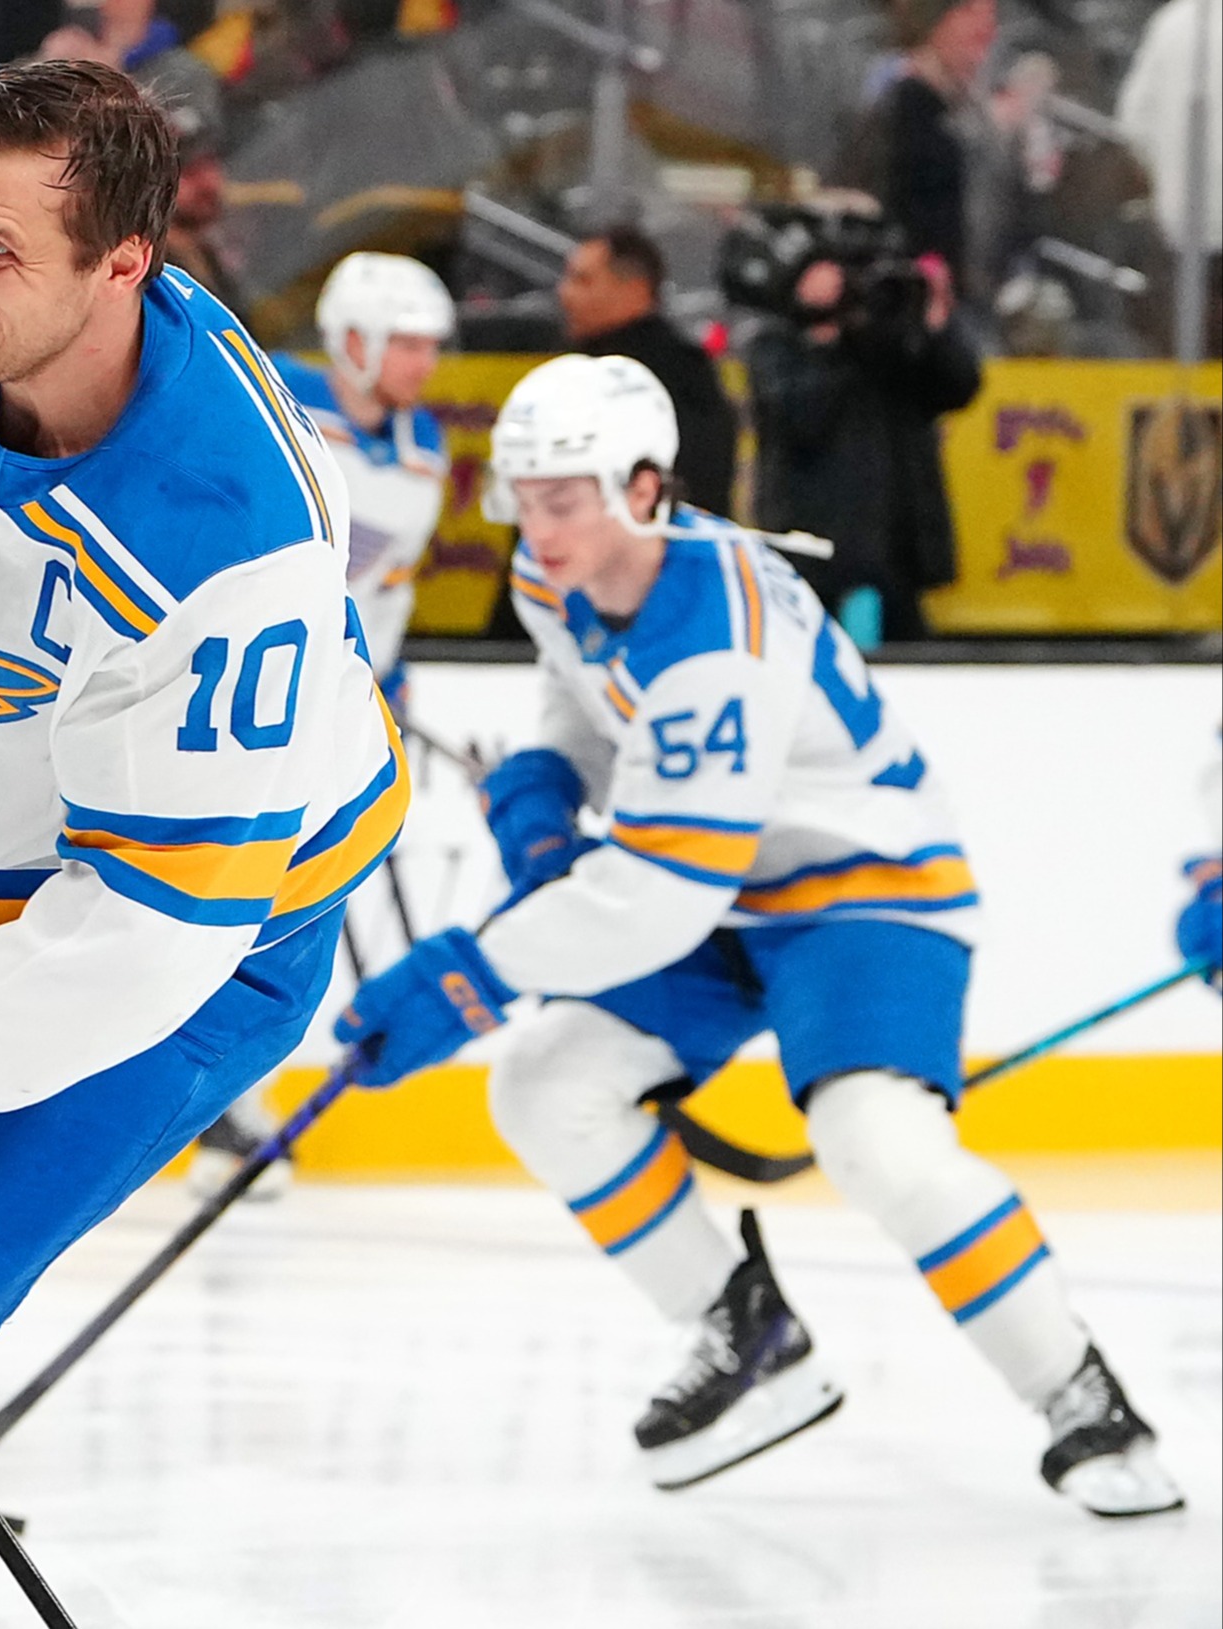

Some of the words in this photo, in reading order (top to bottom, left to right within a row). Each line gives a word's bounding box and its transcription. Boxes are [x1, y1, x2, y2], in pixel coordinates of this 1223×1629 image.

[30, 559, 73, 666] C
[176, 618, 309, 752] 10
[649, 696, 747, 780] 54
